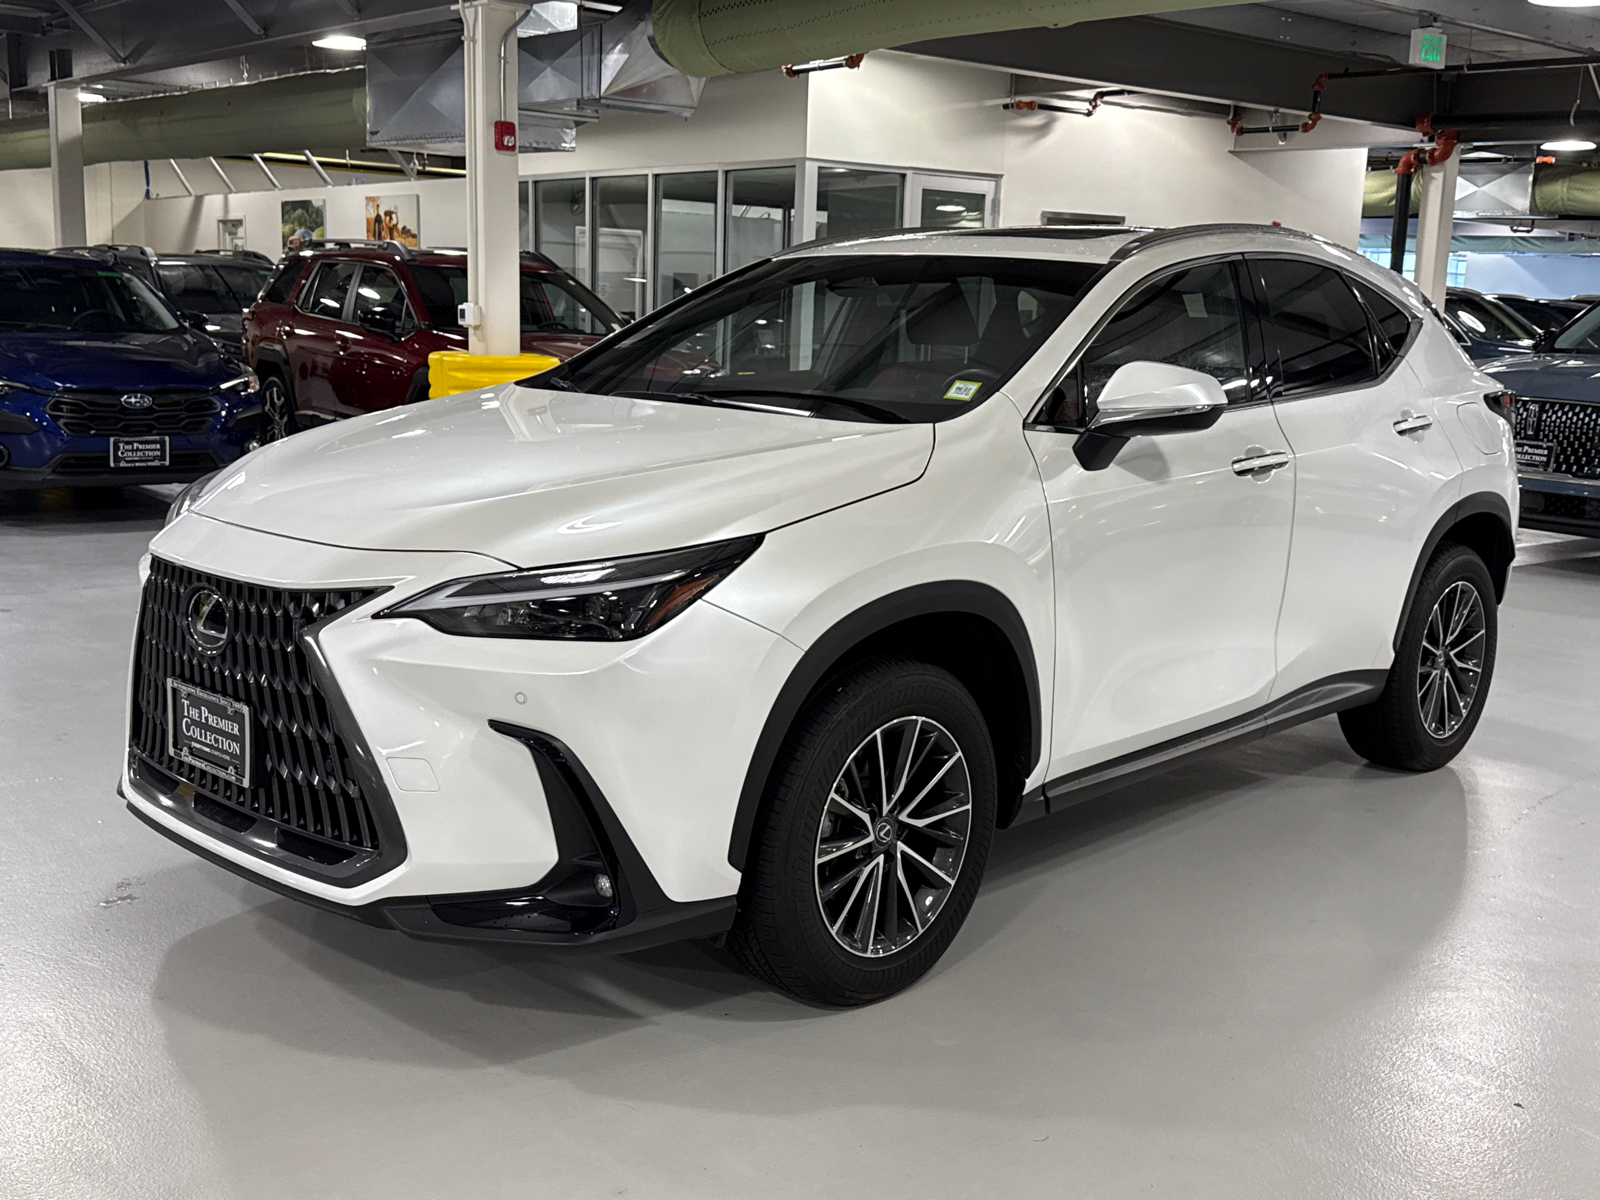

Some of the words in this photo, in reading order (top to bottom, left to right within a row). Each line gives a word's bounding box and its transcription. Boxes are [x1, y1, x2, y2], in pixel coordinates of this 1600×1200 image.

[1421, 34, 1443, 61] EXIT
[1515, 454, 1548, 462] OLLECTION
[1523, 446, 1548, 454] PREMIER
[182, 699, 200, 721] THE
[201, 706, 240, 736] PREMIER
[182, 718, 240, 755] COLLECTION
